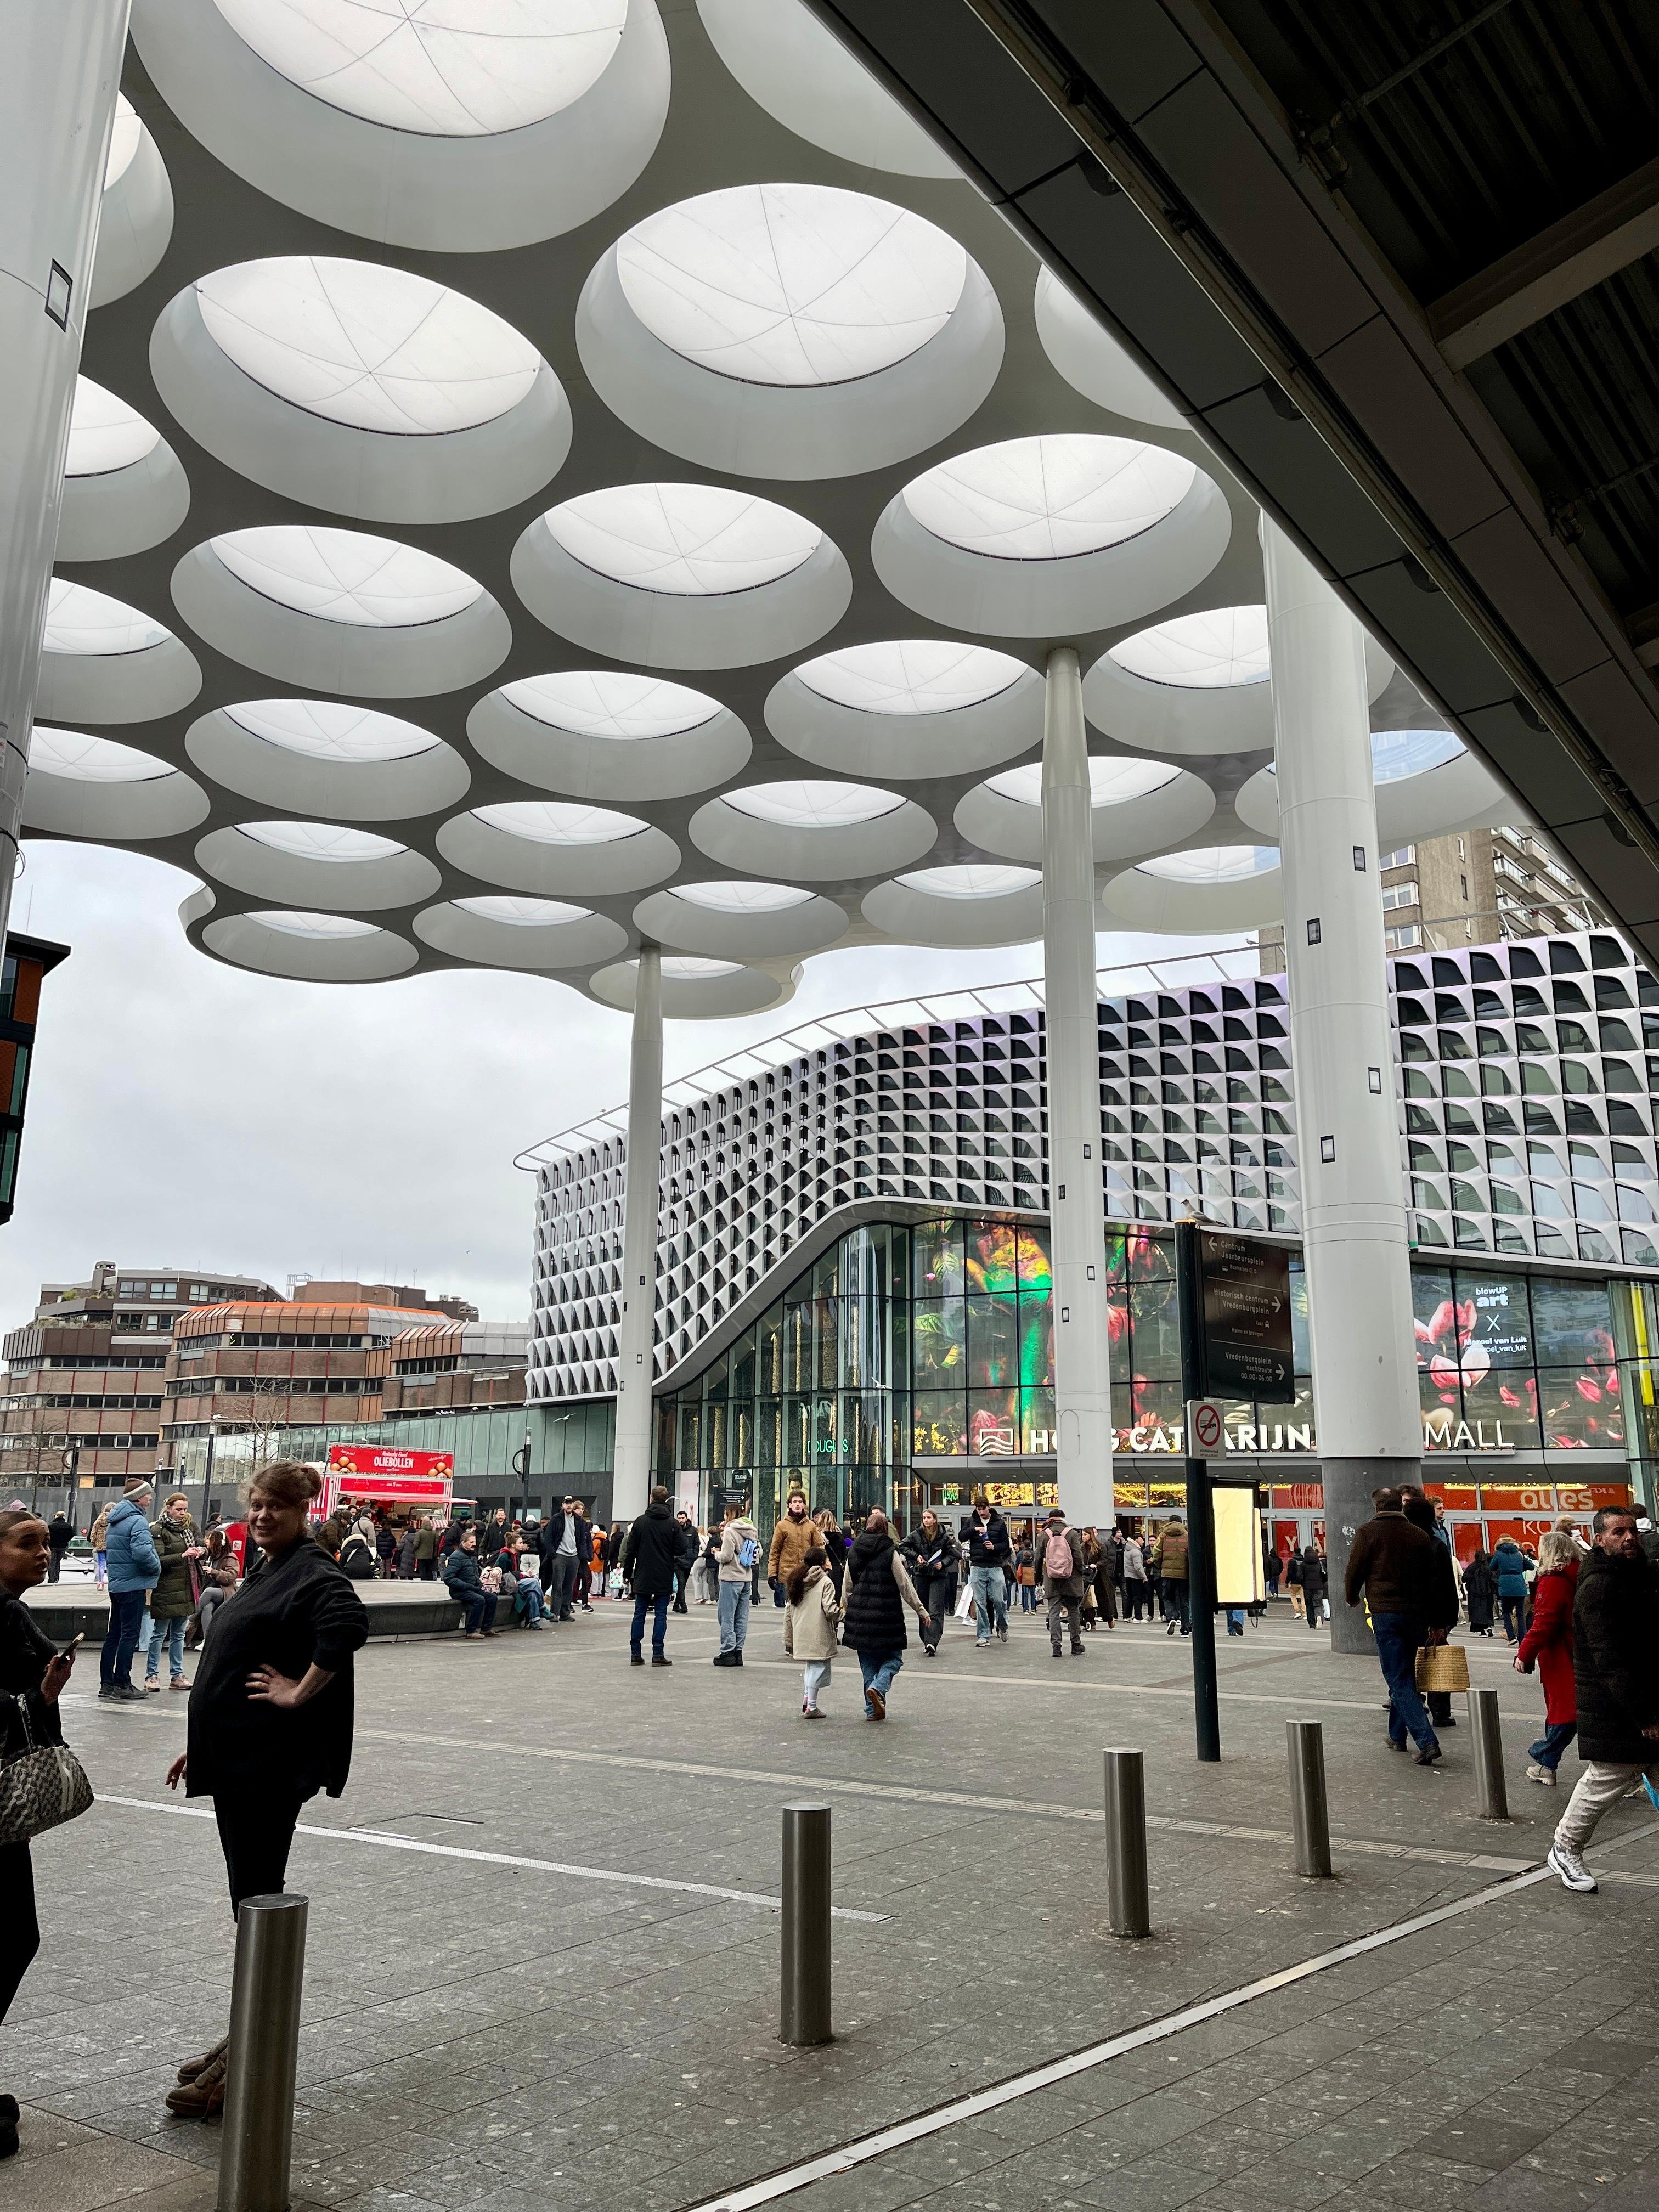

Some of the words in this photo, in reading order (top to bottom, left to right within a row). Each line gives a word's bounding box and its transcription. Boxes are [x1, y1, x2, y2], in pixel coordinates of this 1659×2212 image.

[1221, 1240, 1246, 1252] Centrum
[1221, 1251, 1265, 1266] Jaarbeursplein
[1214, 1288, 1244, 1300] Historisch
[1245, 1295, 1269, 1305] centrum
[1475, 1286, 1508, 1295] blowUP
[1476, 1294, 1509, 1307] art
[1222, 1300, 1270, 1315] Vredenburgplein
[1464, 1338, 1492, 1346] Marcel
[1224, 1351, 1272, 1365] Vredenburgplein
[1246, 1365, 1272, 1374] nachtroute
[1425, 1419, 1515, 1448] MALL
[374, 1456, 414, 1469] OLIEBOLLEN
